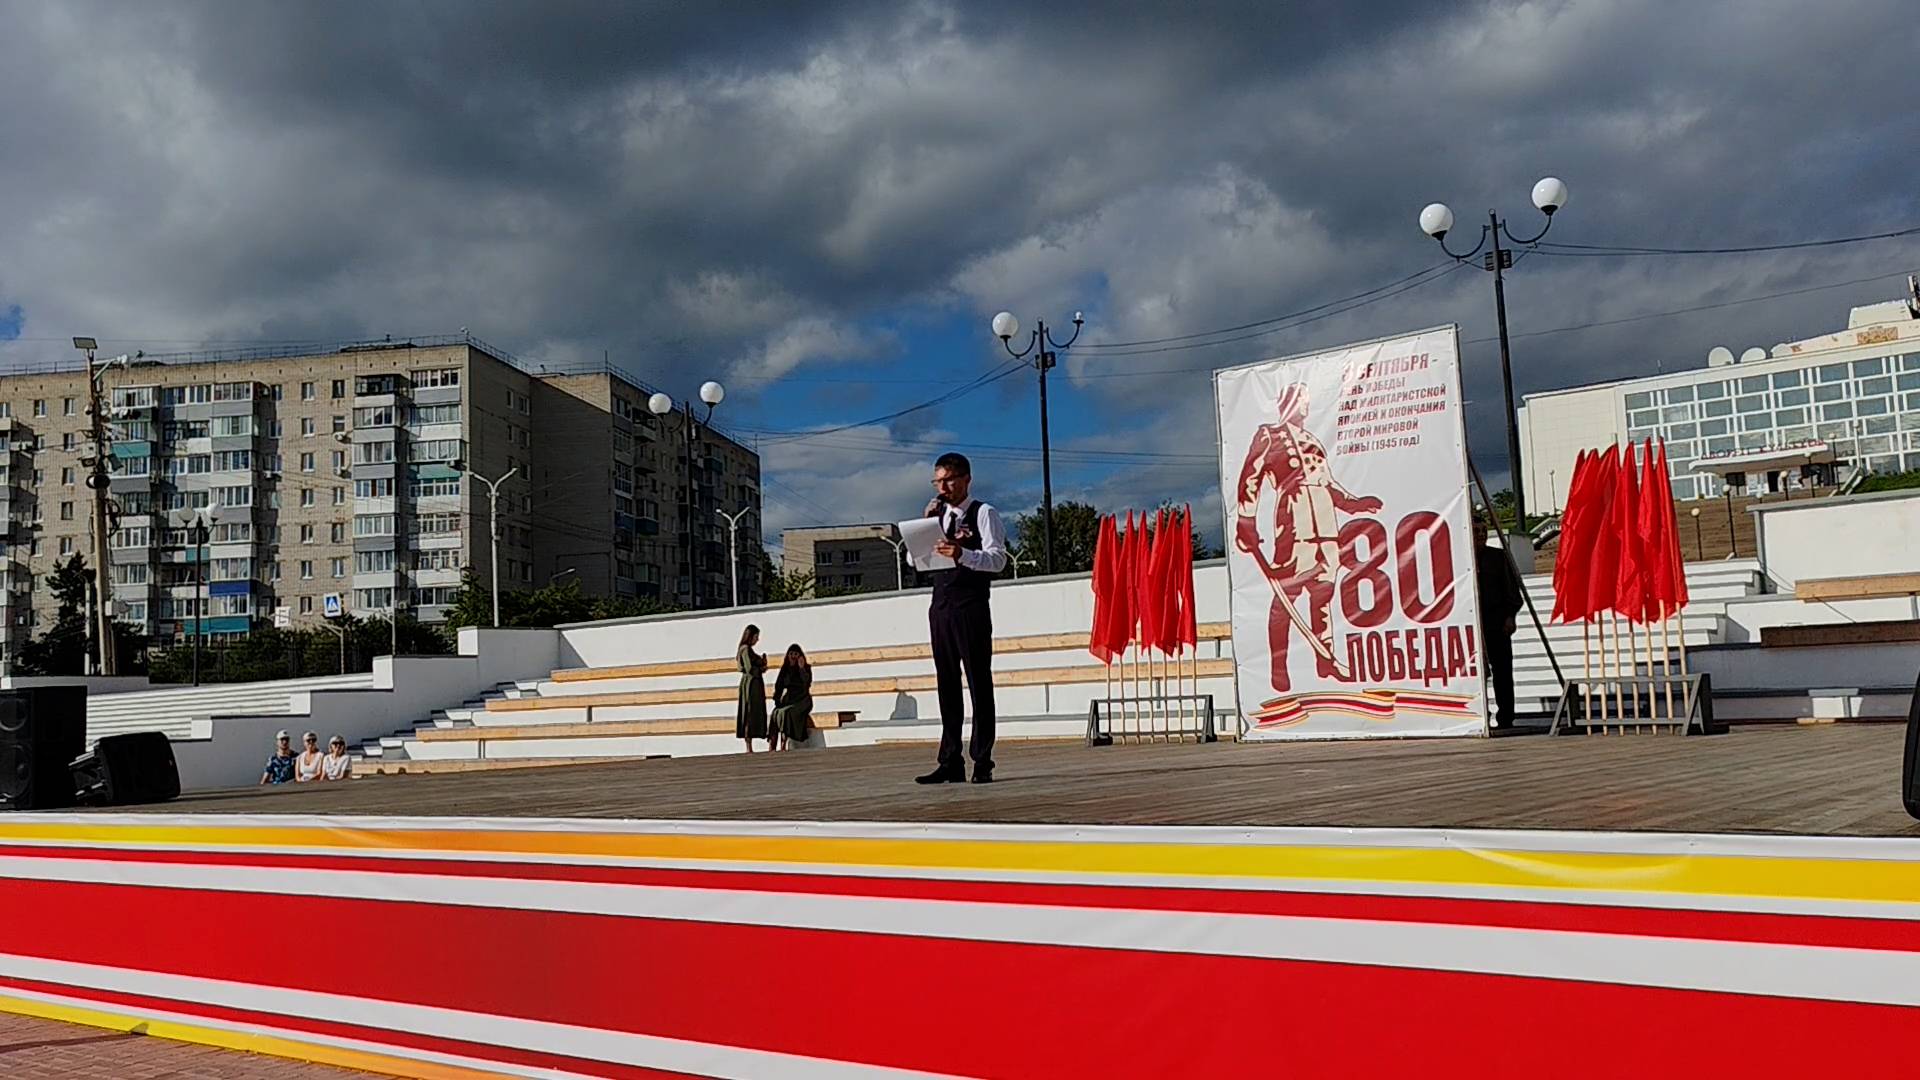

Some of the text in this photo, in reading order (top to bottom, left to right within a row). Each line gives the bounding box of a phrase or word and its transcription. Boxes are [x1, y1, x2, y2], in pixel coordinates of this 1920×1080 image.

[1337, 409, 1378, 426] ЯПОНИЕЙ
[1388, 400, 1446, 418] ОКОНЧАНИЯ
[1373, 418, 1419, 435] МИРОВОЙ
[1339, 511, 1455, 628] 80
[1346, 625, 1478, 687] ПОБЕДА!
